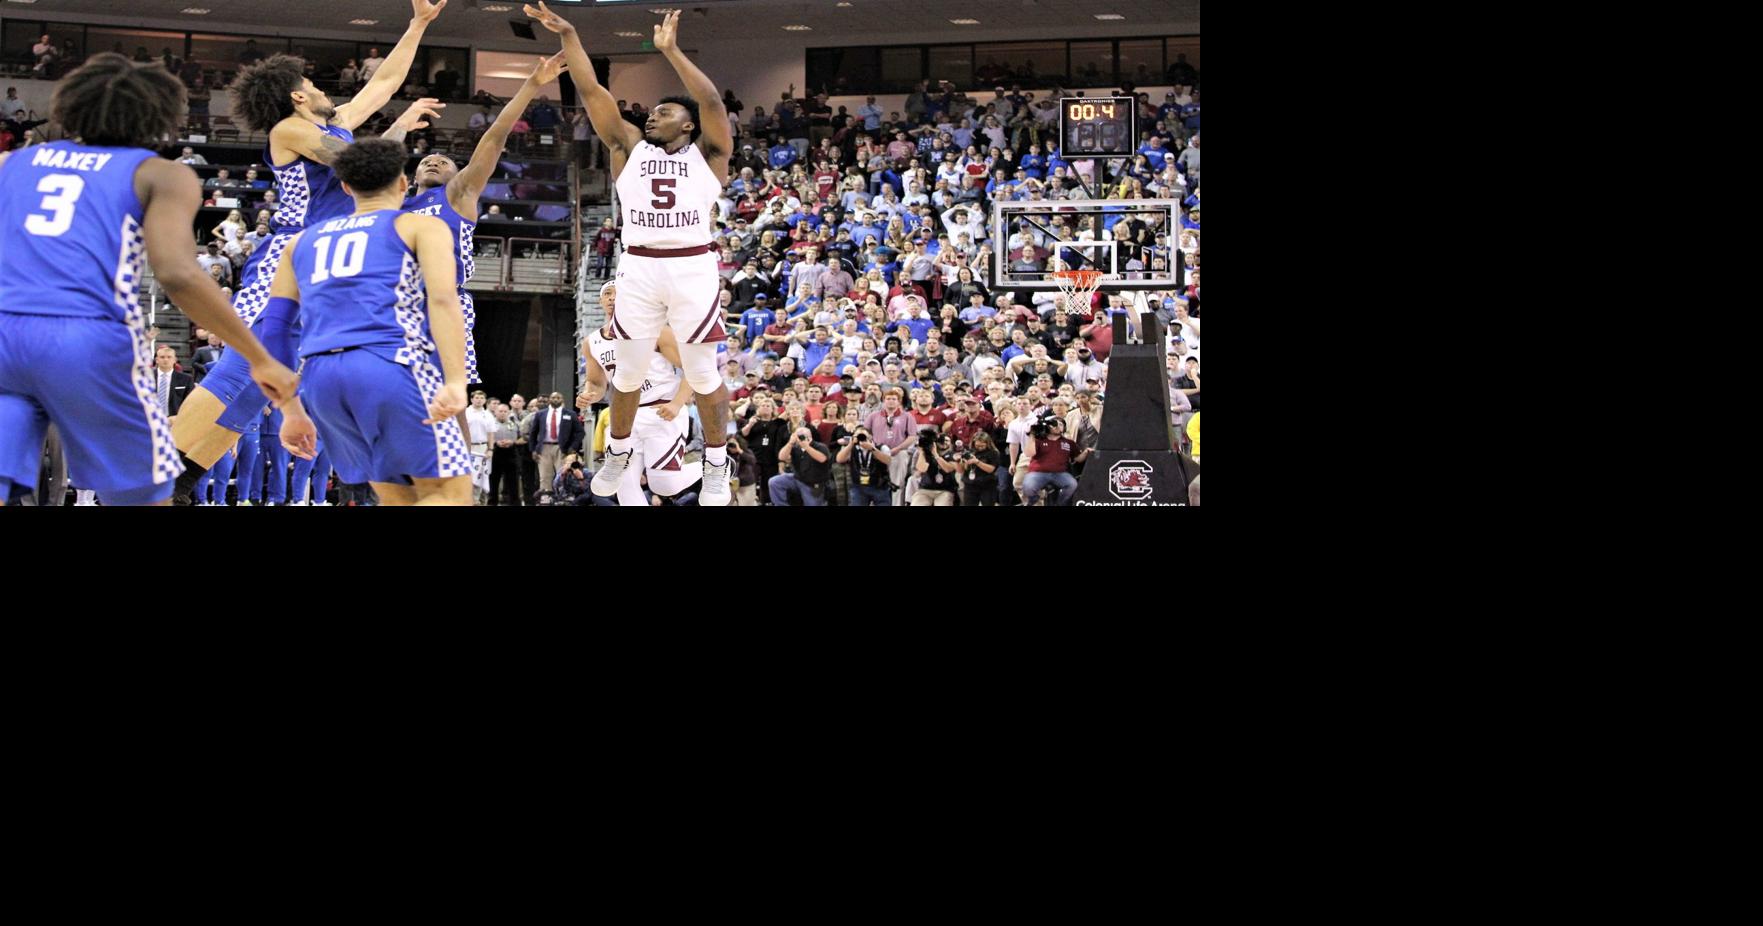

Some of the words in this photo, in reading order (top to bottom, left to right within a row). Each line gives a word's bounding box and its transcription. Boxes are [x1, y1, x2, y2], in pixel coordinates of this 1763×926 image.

[31, 147, 113, 172] MAXEY
[640, 160, 689, 178] SOUTH
[23, 173, 86, 237] 3
[651, 178, 677, 210] 5
[630, 208, 701, 228] CAROLINA
[311, 230, 370, 285] 10
